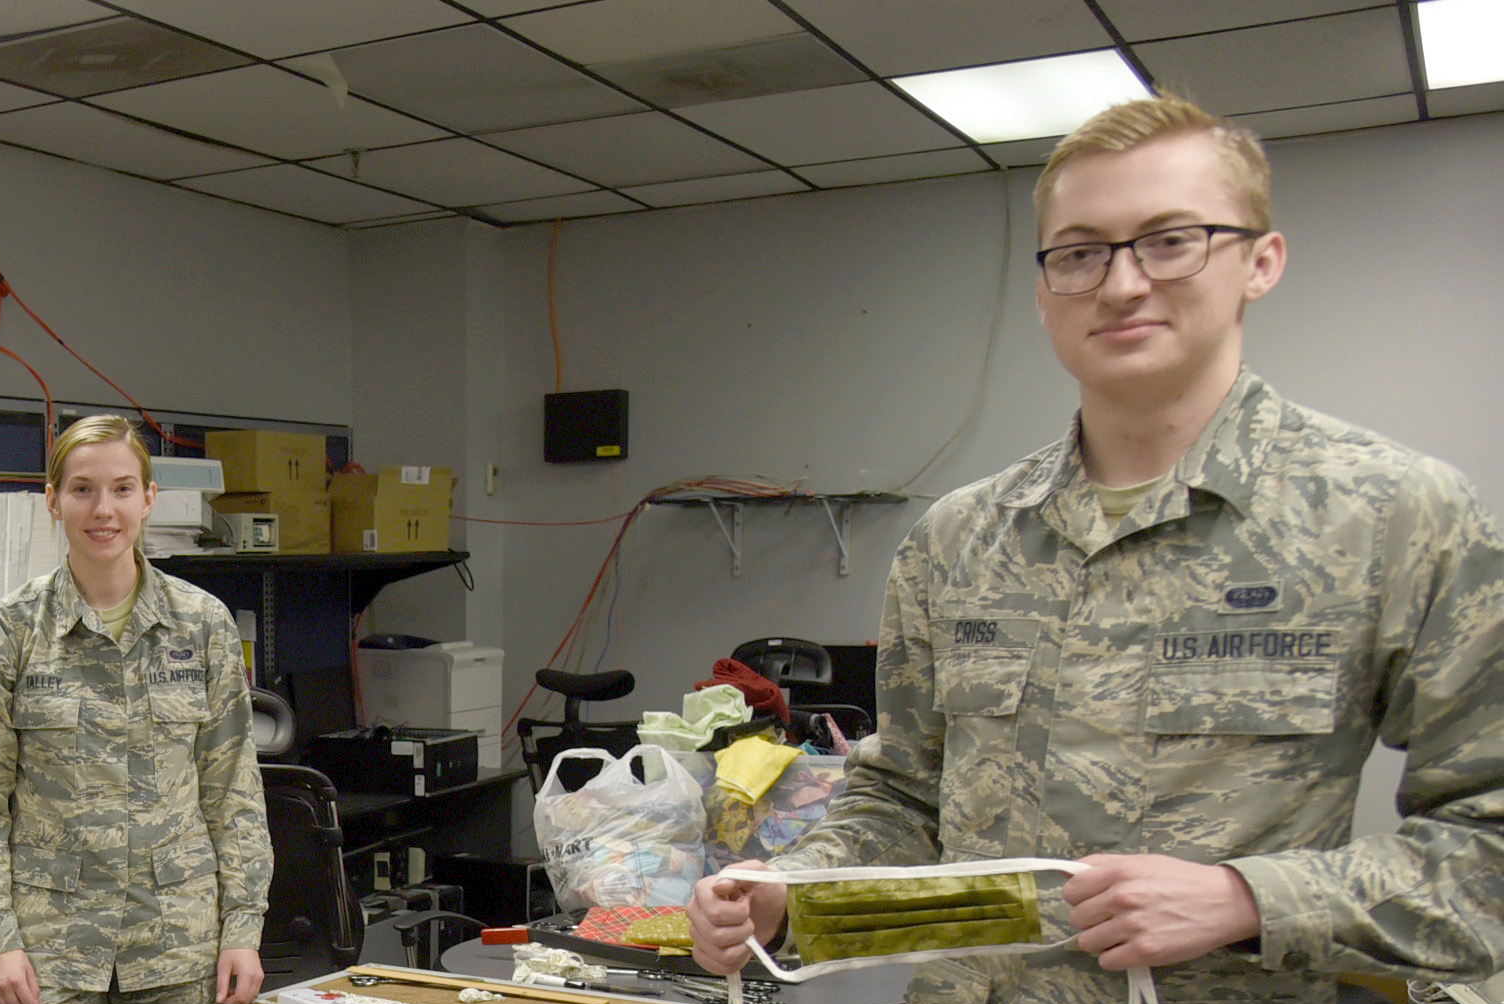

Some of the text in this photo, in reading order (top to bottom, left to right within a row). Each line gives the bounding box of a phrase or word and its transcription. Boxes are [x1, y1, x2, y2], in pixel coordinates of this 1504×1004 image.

[954, 621, 997, 644] CRISS
[1207, 634, 1244, 659] AIR
[1248, 632, 1334, 658] FORCE
[25, 674, 63, 690] TALLEY
[149, 671, 169, 685] U.S.
[169, 669, 186, 683] AIR
